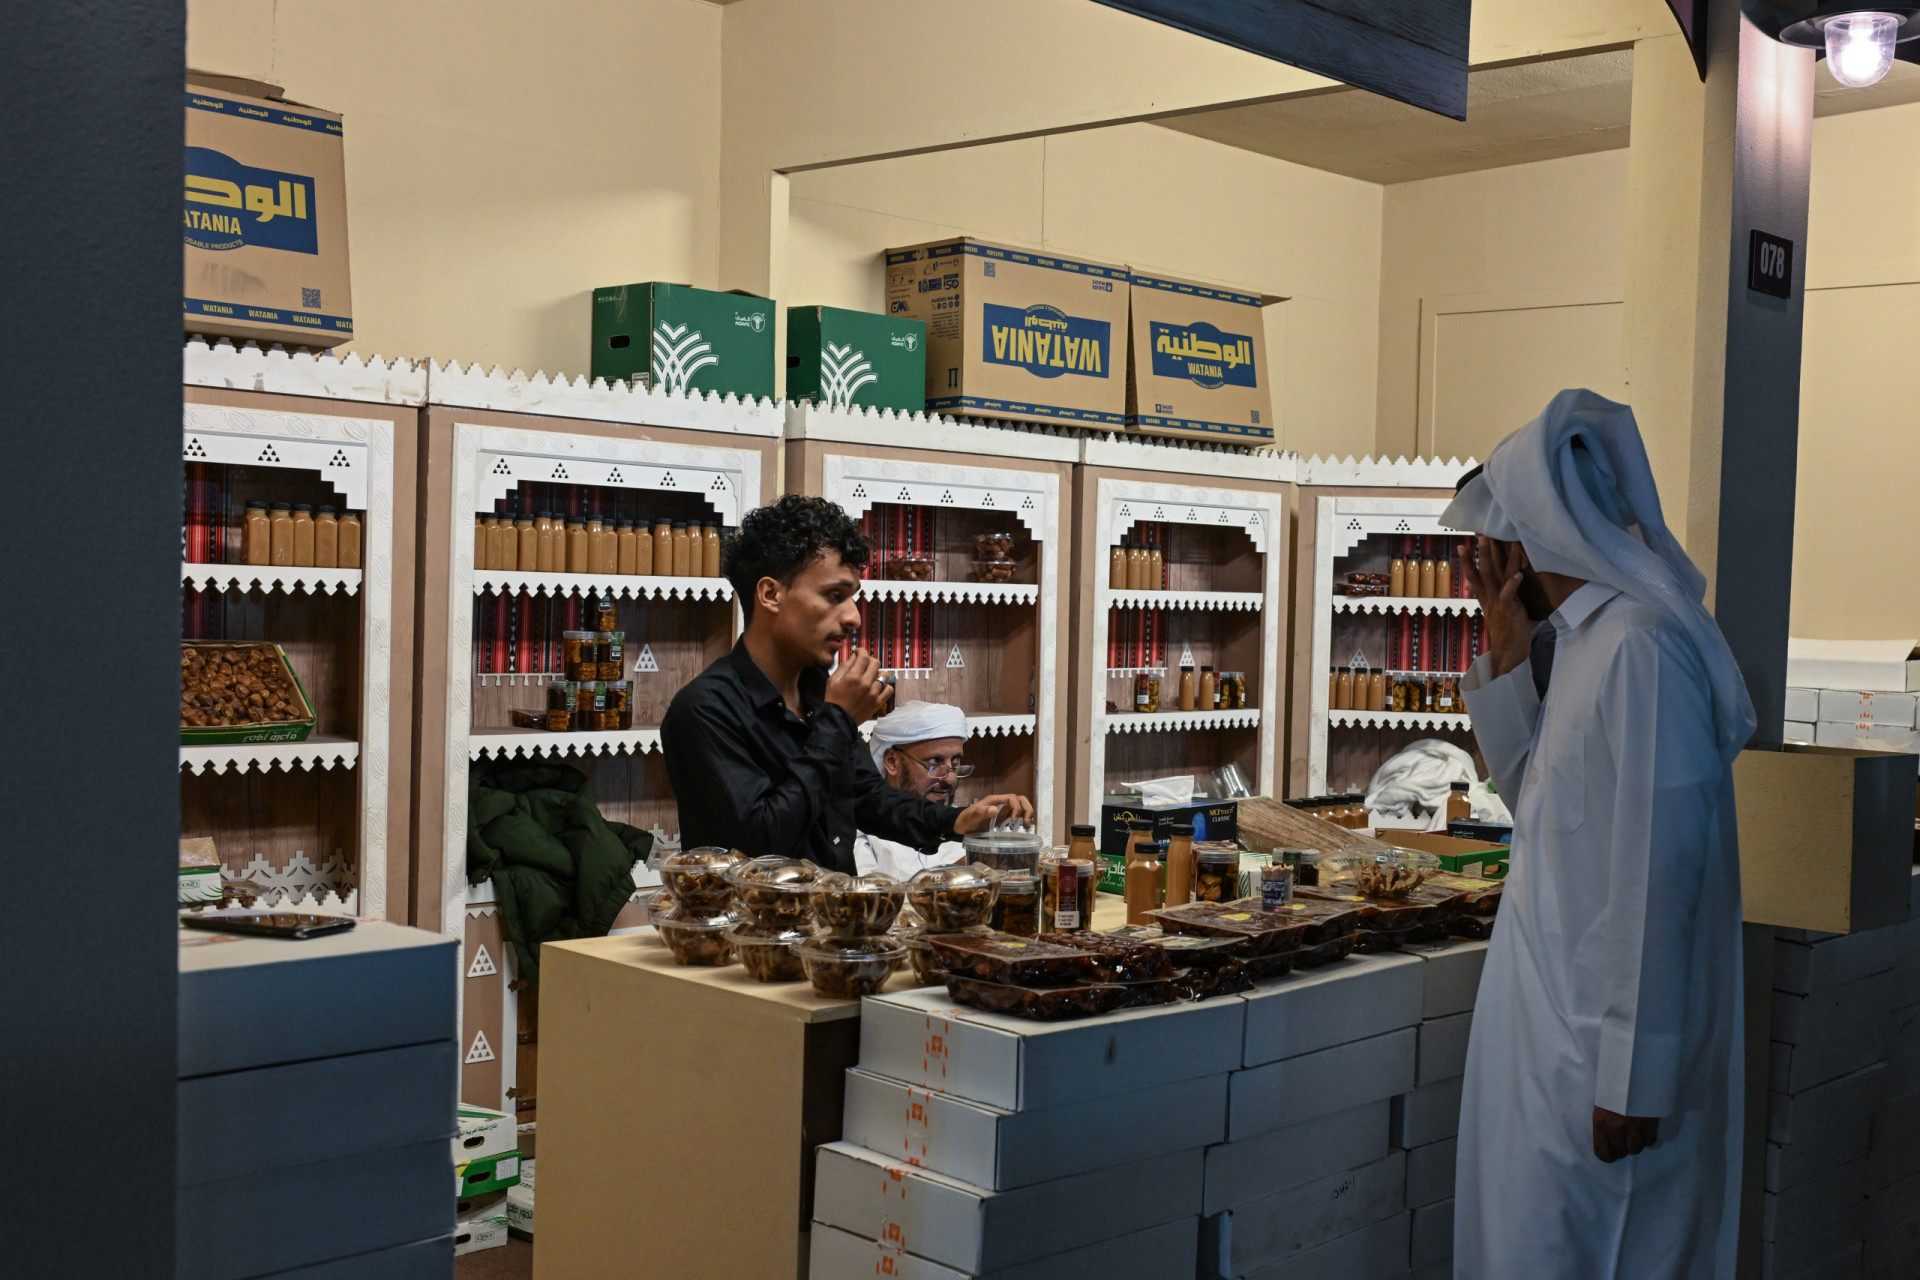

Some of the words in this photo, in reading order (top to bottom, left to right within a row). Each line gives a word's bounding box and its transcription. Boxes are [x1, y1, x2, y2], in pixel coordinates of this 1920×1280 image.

[183, 209, 242, 236] ATANIA
[184, 236, 210, 250] OSABLE
[210, 238, 244, 250] PRODUCTS
[1760, 241, 1785, 280] 078
[202, 303, 233, 315] WATANIA
[248, 309, 279, 320] WATANIA
[292, 315, 322, 326] WATANIA
[335, 320, 353, 329] WATA
[1024, 315, 1068, 333] الوطنية
[991, 324, 1102, 373] WATANIA
[1157, 328, 1251, 369] الوطنية
[1187, 362, 1223, 379] WATANIA
[1212, 815, 1231, 823] CLASSIC
